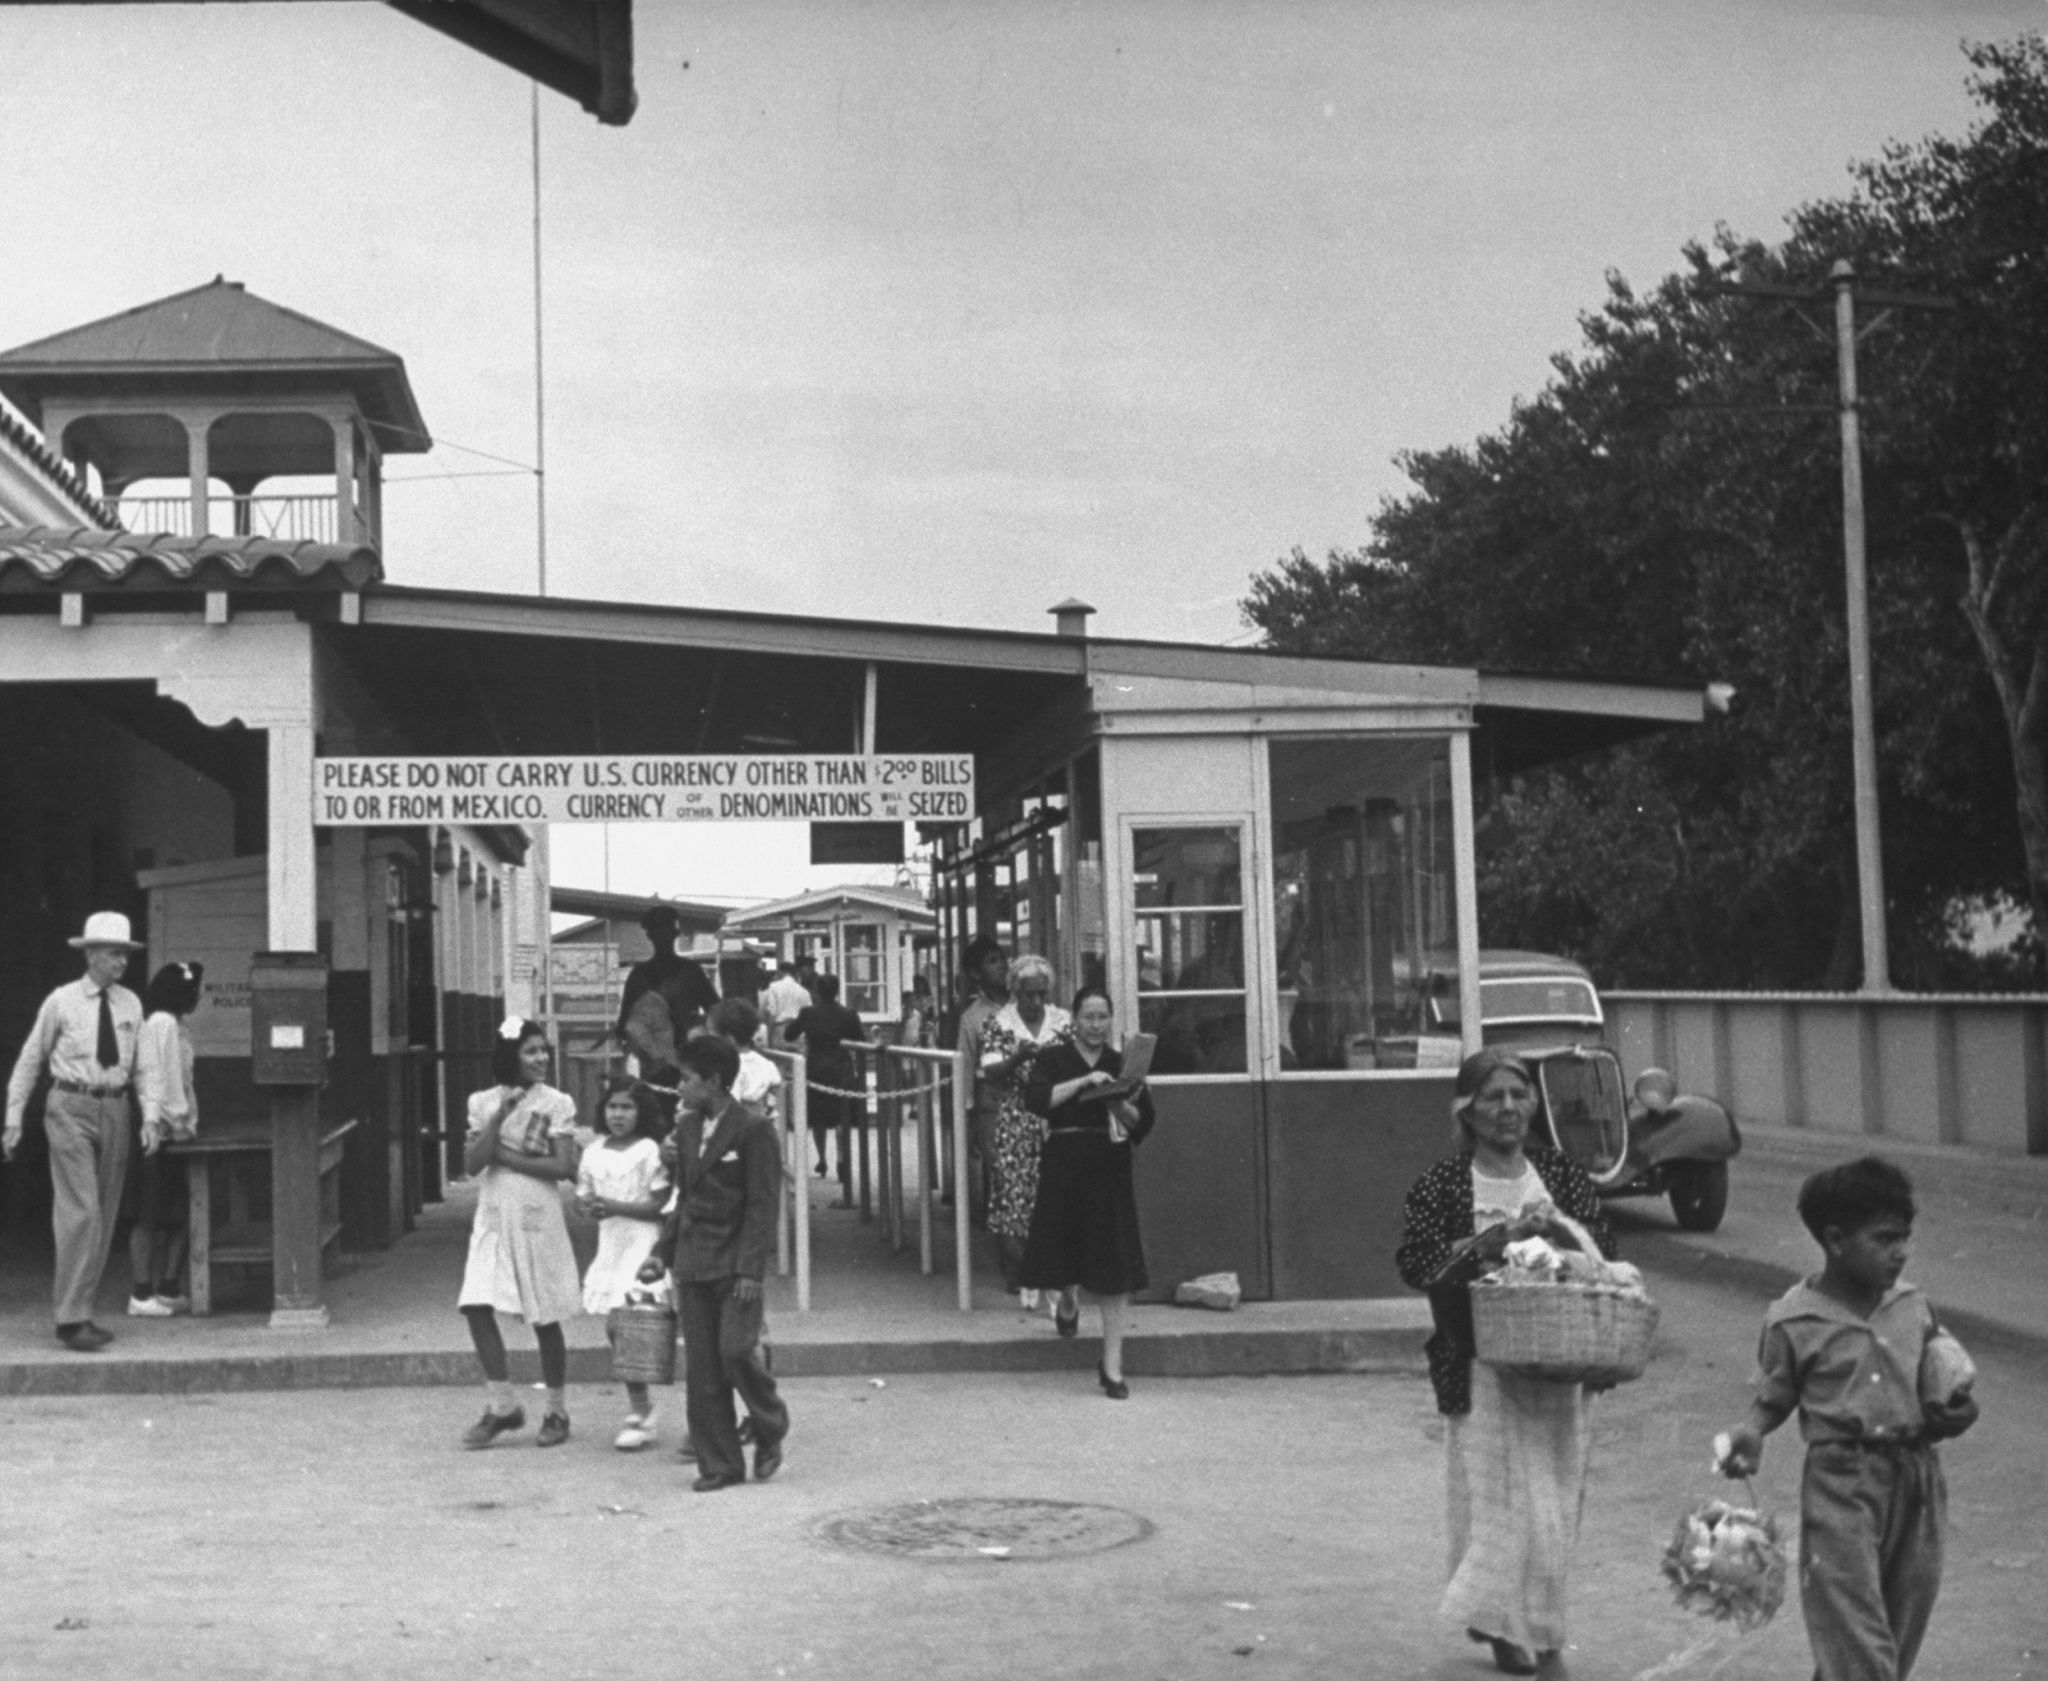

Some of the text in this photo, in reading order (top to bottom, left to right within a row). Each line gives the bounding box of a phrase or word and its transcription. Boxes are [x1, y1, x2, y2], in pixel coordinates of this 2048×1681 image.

[324, 763, 401, 787] PLEASE
[407, 763, 439, 787] DO
[447, 763, 488, 787] NOT
[496, 762, 573, 787] CARRY
[583, 762, 627, 787] U.S.
[631, 761, 738, 786] CURRENCY
[746, 761, 807, 786] OTHER
[814, 761, 867, 785] THAN
[922, 760, 971, 785] BILLS
[324, 792, 967, 820] TO OR FROM MEXICO. CURRENCY OF OTHER DENOMINATIONS WILL BE SEIZED
[205, 982, 252, 993] MILITAR
